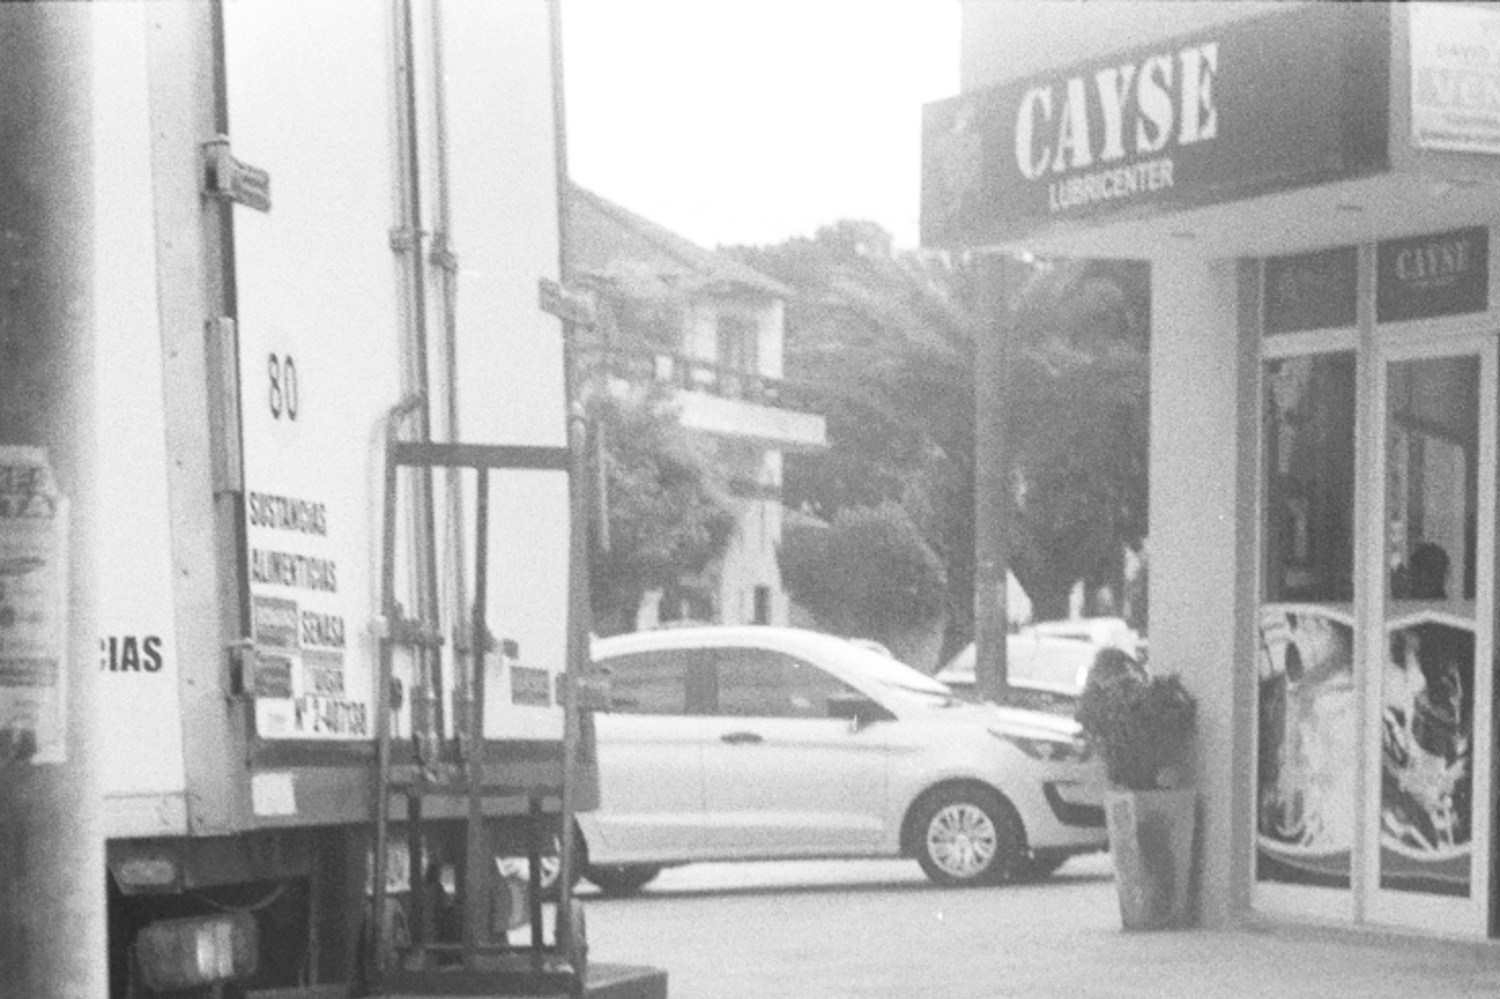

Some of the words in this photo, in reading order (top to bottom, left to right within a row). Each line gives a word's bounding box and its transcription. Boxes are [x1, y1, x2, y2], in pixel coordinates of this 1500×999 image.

[1015, 42, 1218, 180] CAYSE
[1049, 159, 1174, 212] LUBRICENTER
[267, 352, 298, 421] 80
[250, 491, 327, 537] SUSTANCIAS
[252, 548, 337, 593] ALIMENTICIAS
[100, 635, 163, 673] IAS
